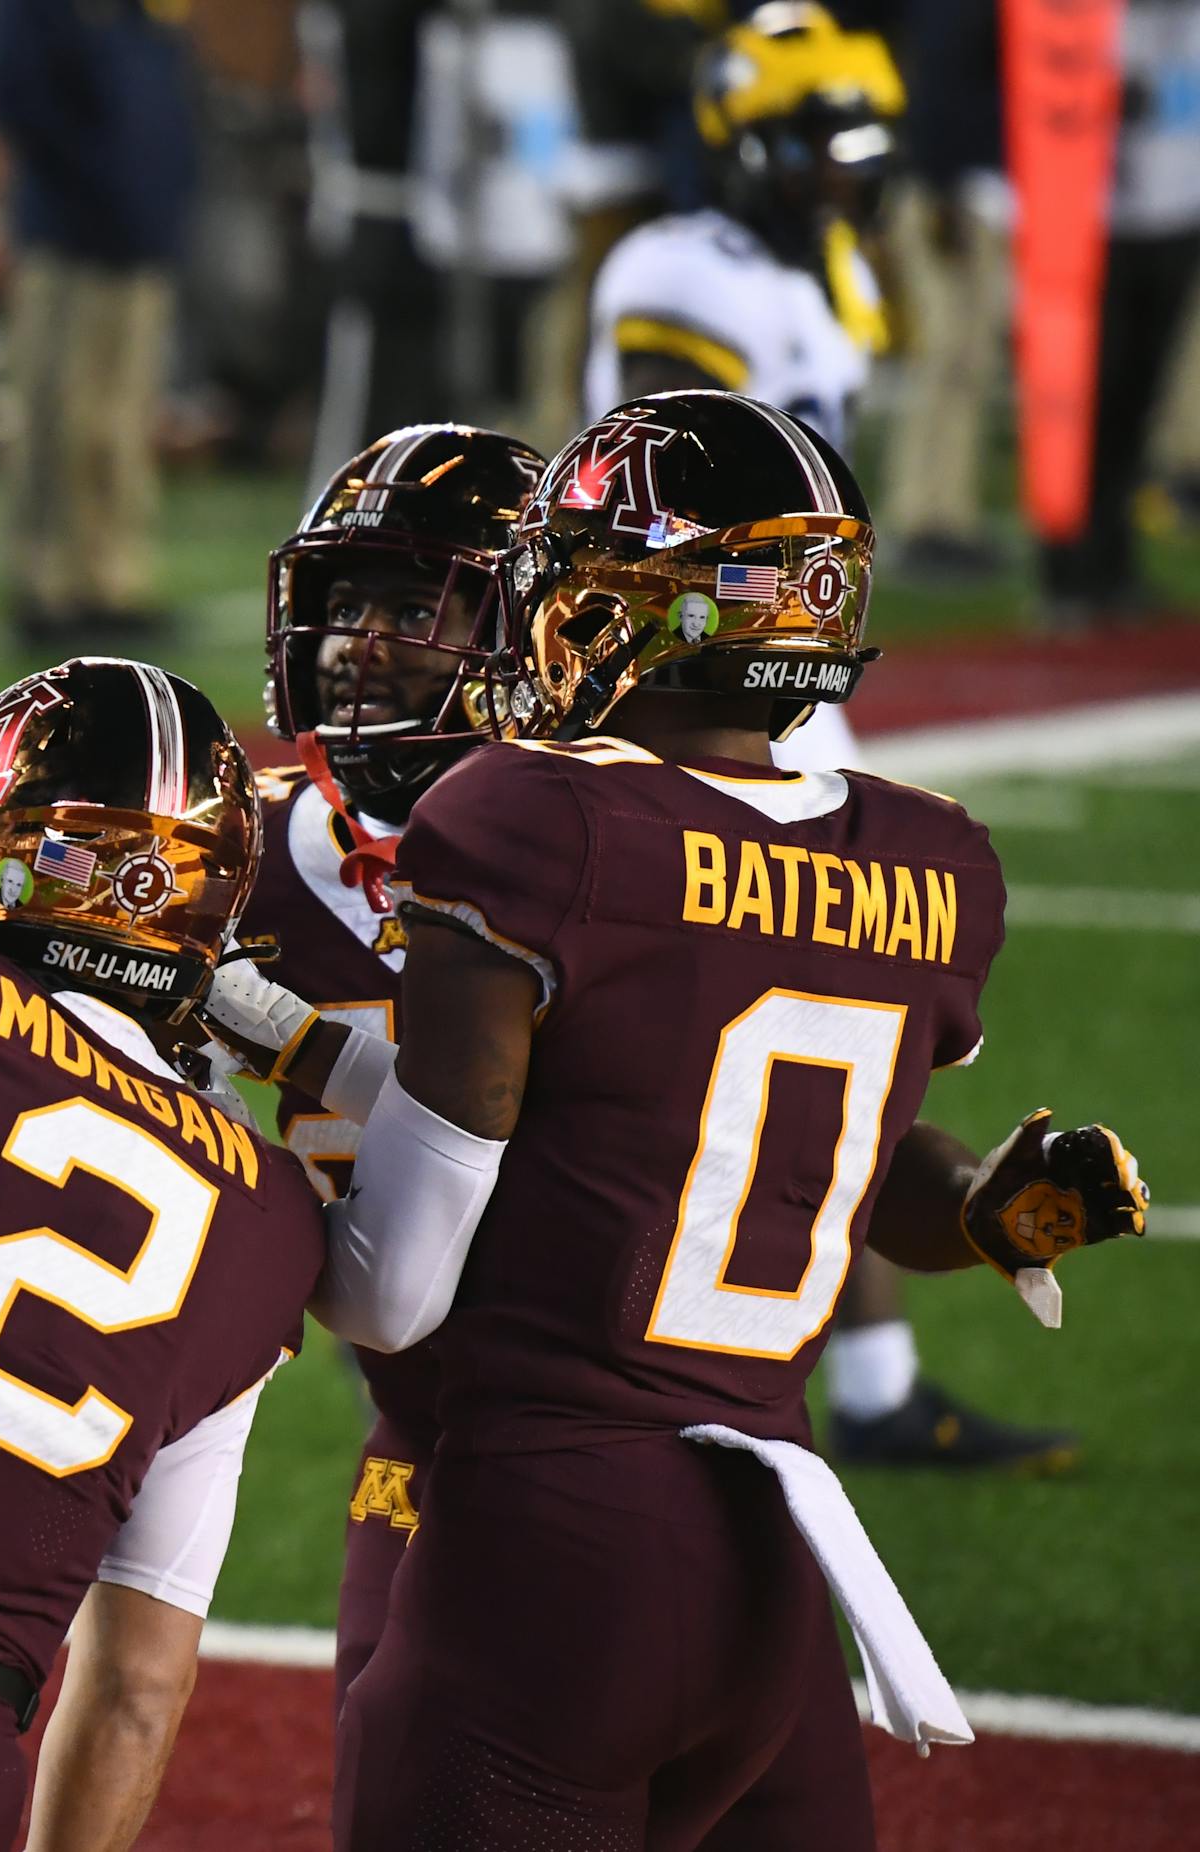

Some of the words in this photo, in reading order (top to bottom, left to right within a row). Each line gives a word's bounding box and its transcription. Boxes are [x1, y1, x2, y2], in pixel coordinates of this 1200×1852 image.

[819, 573, 833, 600] 0
[743, 661, 852, 693] SKI-U-MAH
[133, 871, 154, 899] 2
[682, 829, 957, 965] BATEMAN
[42, 940, 178, 991] SKI-U-MAH
[644, 986, 909, 1361] 0
[350, 1457, 420, 1530] M
